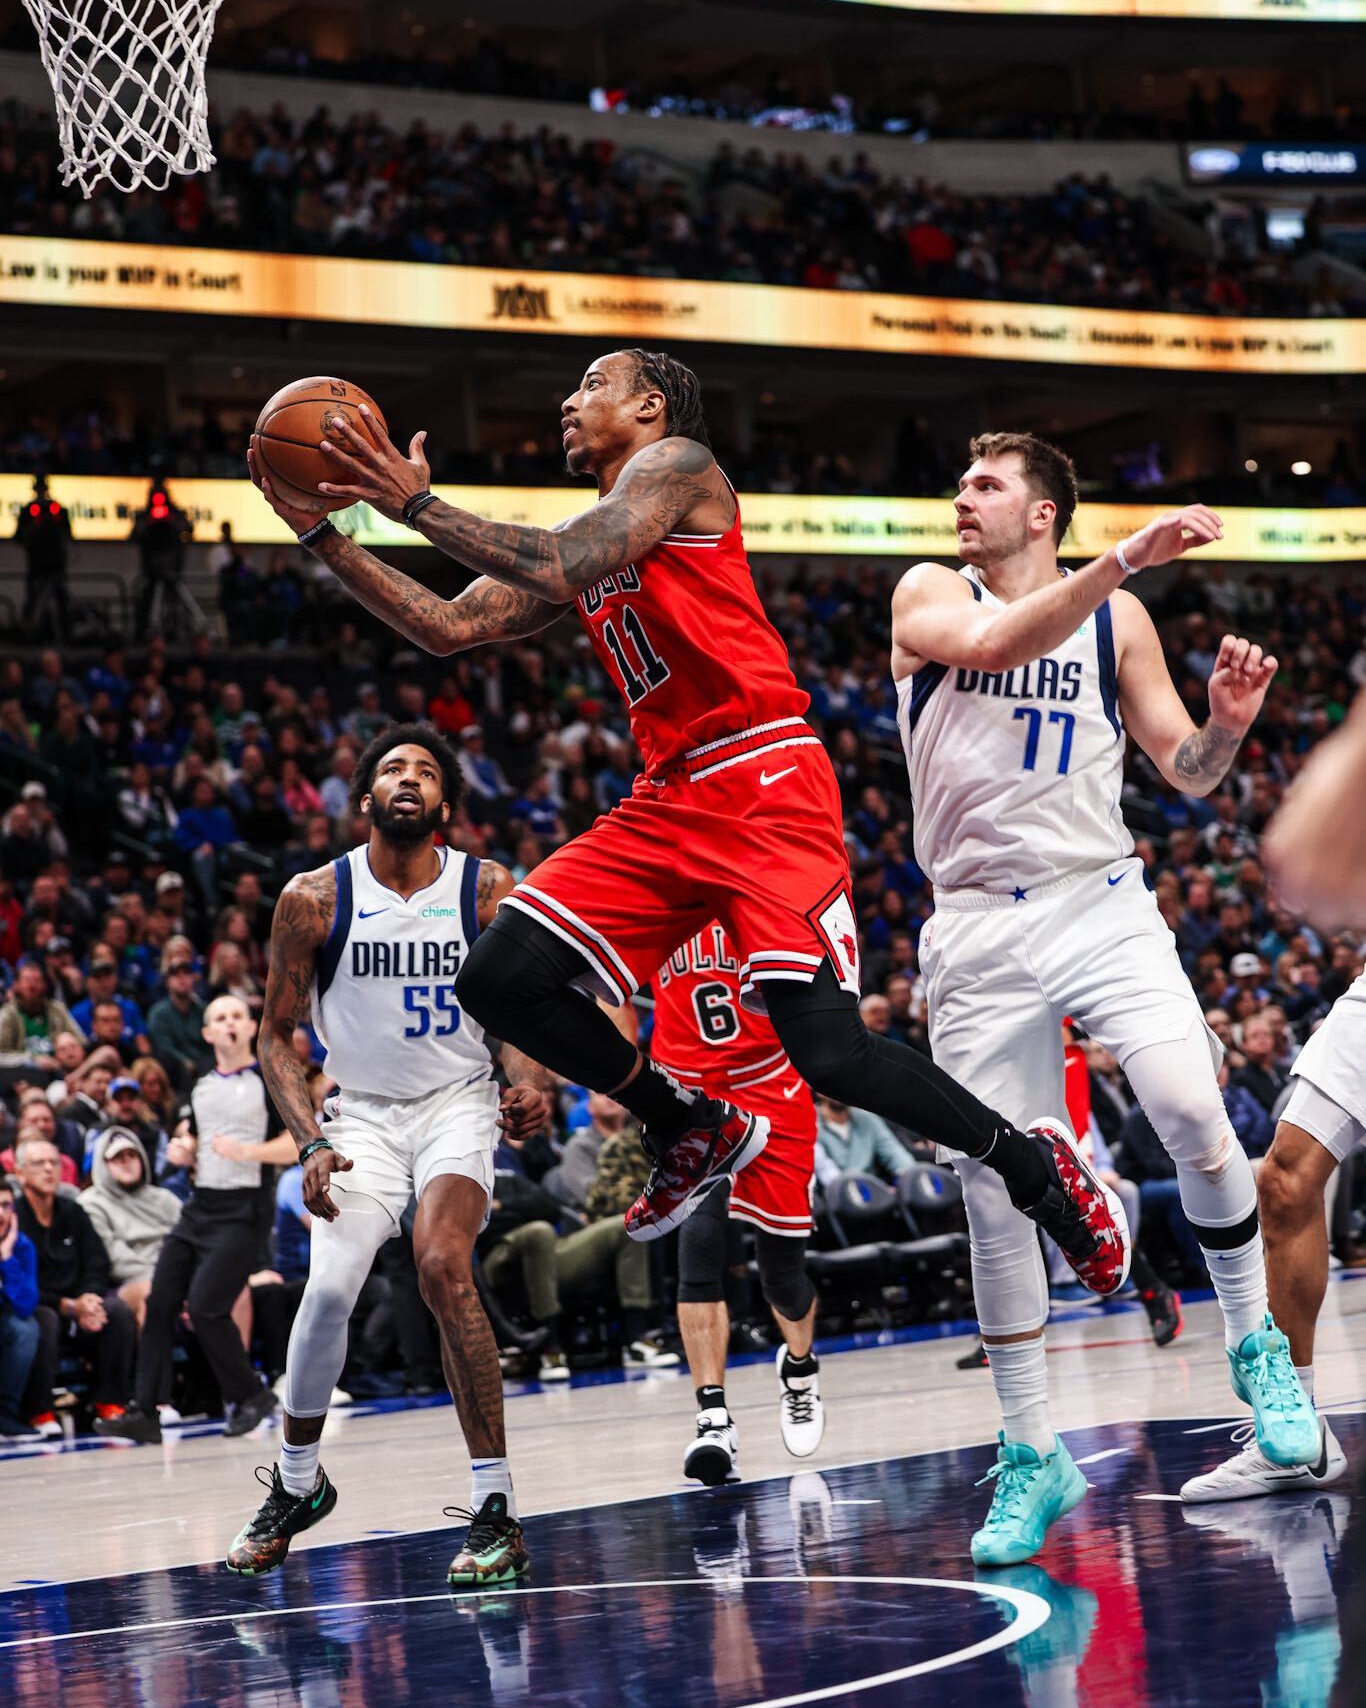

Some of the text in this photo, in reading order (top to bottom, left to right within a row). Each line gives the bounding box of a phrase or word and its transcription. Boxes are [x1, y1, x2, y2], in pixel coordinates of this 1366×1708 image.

[603, 604, 670, 708] 11
[1012, 707, 1076, 776] 77
[421, 906, 456, 918] chime
[352, 941, 460, 977] DALLAS
[403, 985, 460, 1038] 55
[691, 981, 741, 1045] 6
